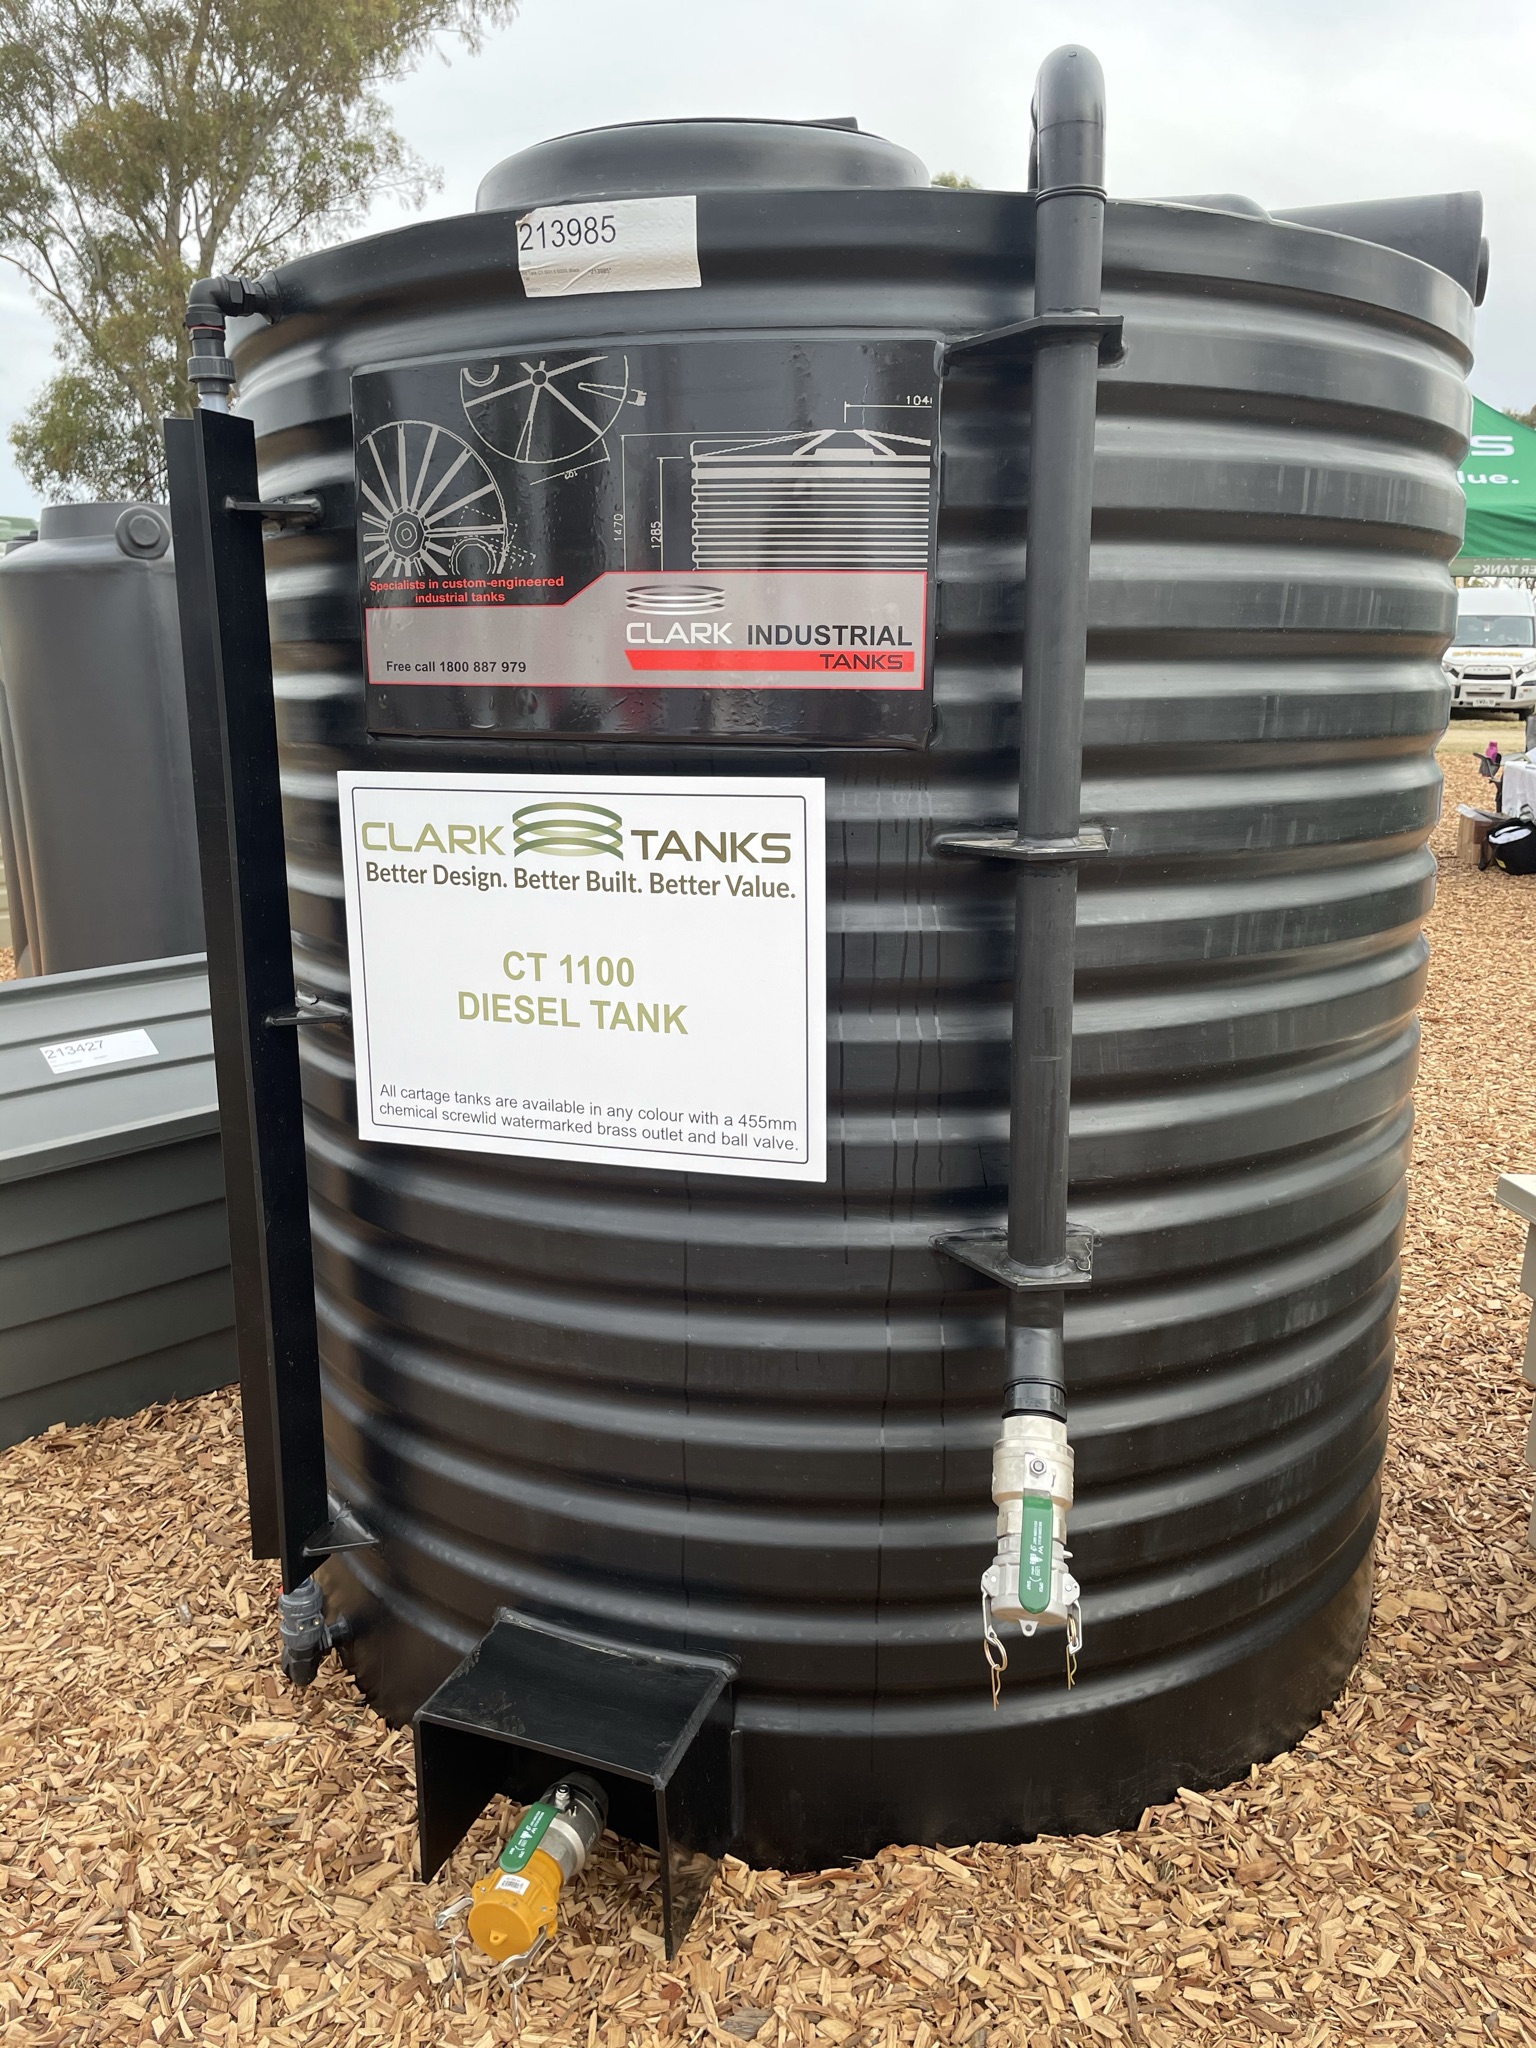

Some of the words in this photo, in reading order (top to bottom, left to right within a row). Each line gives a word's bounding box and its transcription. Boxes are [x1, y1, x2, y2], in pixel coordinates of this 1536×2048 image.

[519, 215, 616, 251] 213985
[1457, 470, 1520, 484] lue.
[613, 513, 623, 541] 1470
[650, 521, 662, 549] 1285
[369, 579, 426, 592] Specialists
[428, 578, 439, 589] in
[442, 576, 564, 590] custom-engineered
[415, 592, 468, 603] industrial
[471, 592, 506, 602] tanks
[626, 622, 733, 644] CLARK
[748, 624, 912, 646] INDUSTRIAL
[386, 661, 411, 672] Free
[415, 661, 436, 672] call
[440, 661, 469, 673] 1800
[473, 661, 497, 673] 887
[501, 661, 527, 673] 979
[820, 653, 903, 670] TANKS
[361, 821, 506, 856] CLARK
[630, 829, 791, 864] TANKS
[366, 861, 428, 884] Better
[433, 864, 508, 891] Design.
[514, 867, 580, 892] Better
[586, 870, 643, 893] Built.
[649, 872, 721, 896] Better
[724, 875, 796, 898] Value.
[503, 950, 547, 982] CT
[559, 954, 635, 987] 1100
[458, 991, 581, 1028] DIESEL
[590, 1000, 689, 1035] TANK
[44, 1040, 104, 1060] 213427
[380, 1084, 396, 1098] All
[400, 1086, 450, 1105] cartage
[454, 1091, 491, 1106] tanks
[495, 1097, 518, 1108] are
[522, 1098, 585, 1115] available
[589, 1102, 602, 1116] in
[606, 1106, 633, 1121] any
[638, 1108, 684, 1123] colour
[688, 1111, 719, 1125] with
[724, 1115, 733, 1126] a
[738, 1114, 797, 1131] 455mm
[379, 1103, 438, 1119] chemical
[442, 1109, 497, 1125] screwlid
[500, 1115, 592, 1134] watermarked
[597, 1124, 637, 1138] brass
[642, 1127, 683, 1142] outlet
[688, 1131, 716, 1144] and
[721, 1132, 748, 1147] ball
[753, 1136, 799, 1151] valve.
